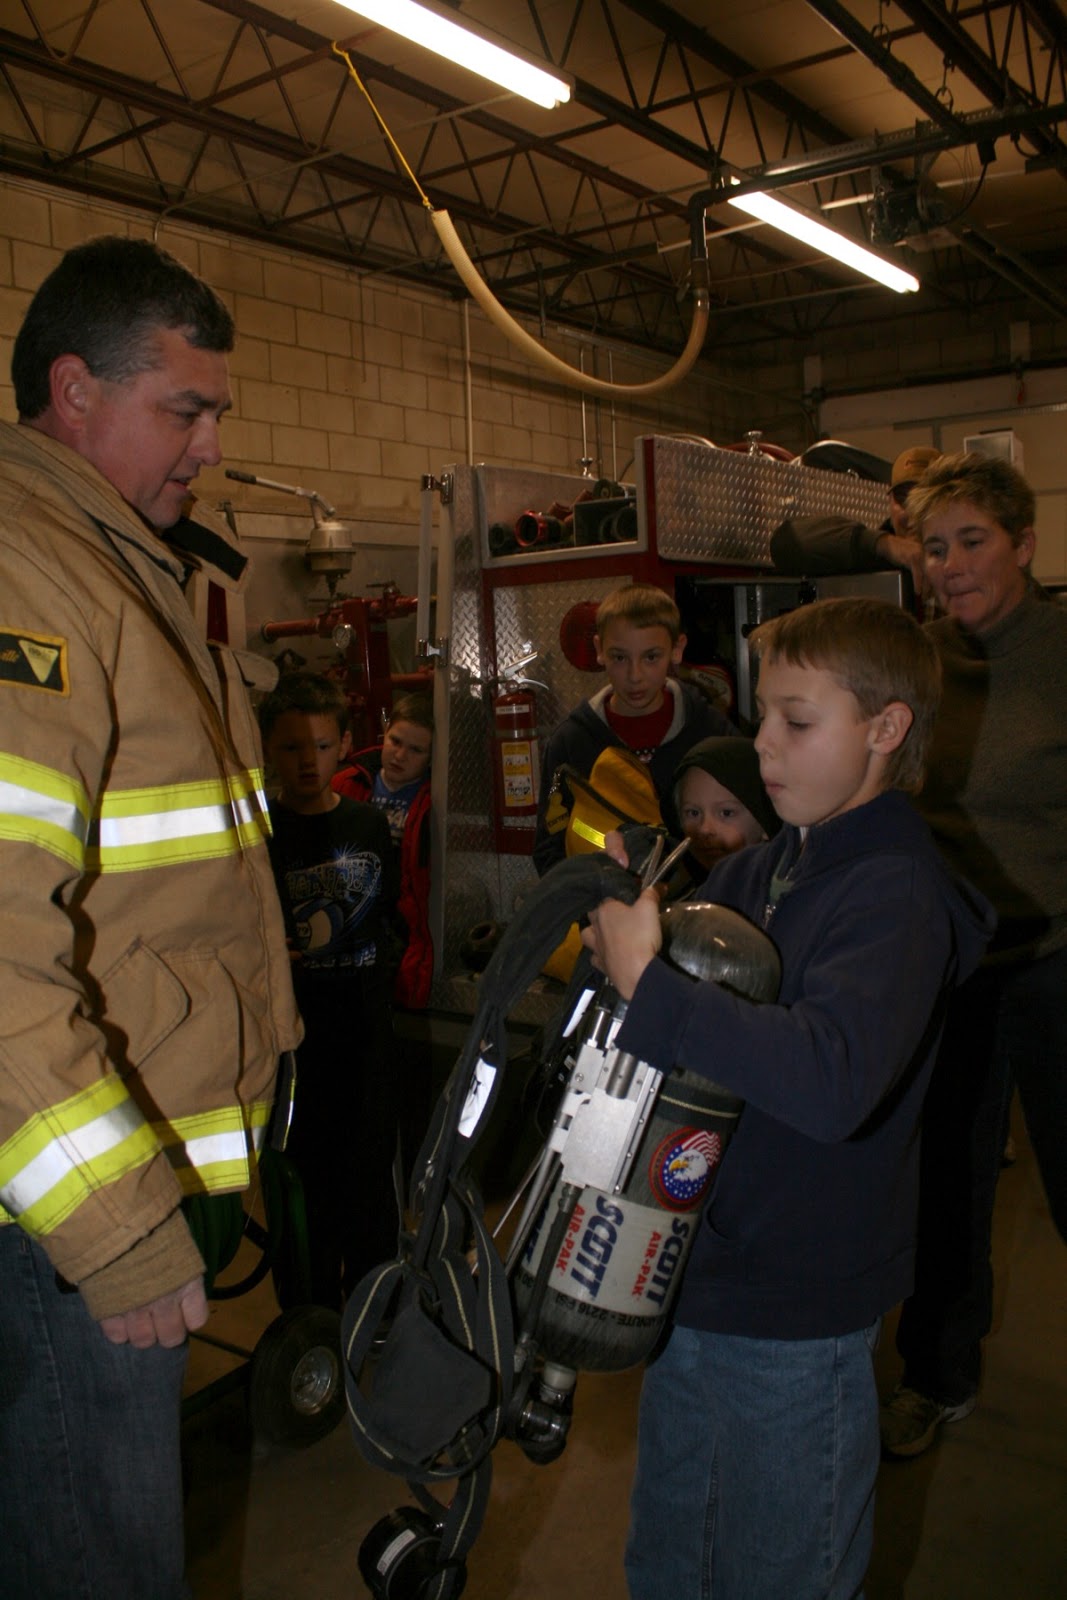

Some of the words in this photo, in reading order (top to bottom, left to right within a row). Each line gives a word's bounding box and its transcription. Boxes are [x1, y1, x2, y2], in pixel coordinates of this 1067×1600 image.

[556, 1203, 585, 1272] AIR-PAK
[570, 1195, 624, 1298] SCOTT
[632, 1231, 662, 1296] AIR-PAK
[646, 1217, 690, 1307] SCOTT
[578, 1302, 609, 1320] 2216
